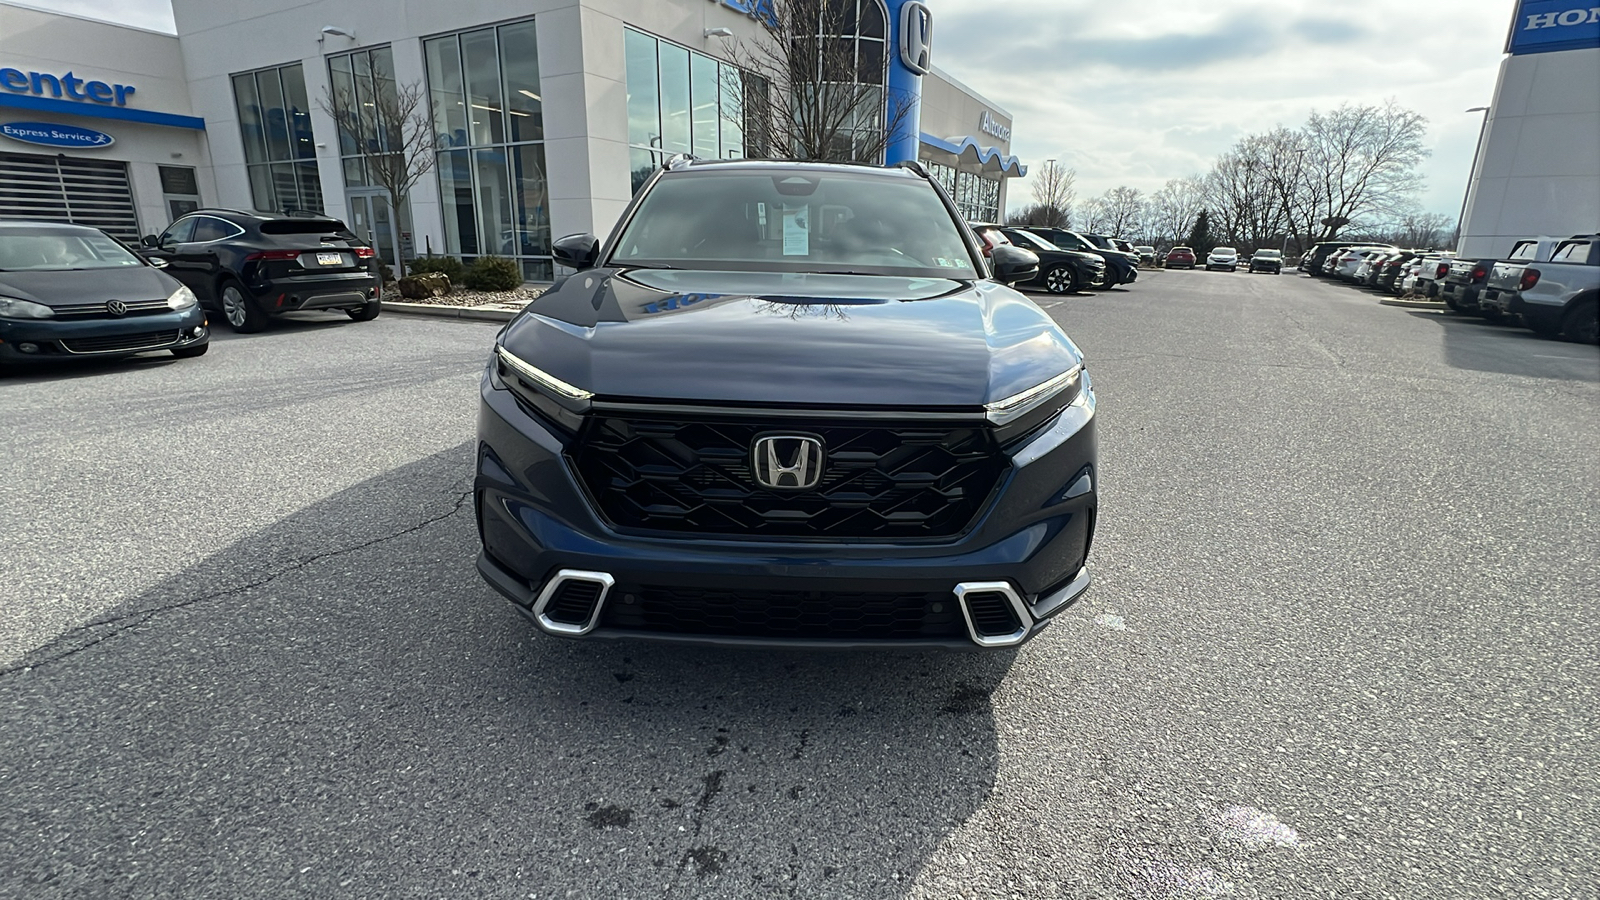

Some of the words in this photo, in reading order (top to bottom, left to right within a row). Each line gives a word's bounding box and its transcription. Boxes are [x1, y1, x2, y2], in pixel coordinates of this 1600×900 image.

[0, 68, 135, 106] enter
[3, 125, 49, 137] Express
[51, 130, 92, 142] Service
